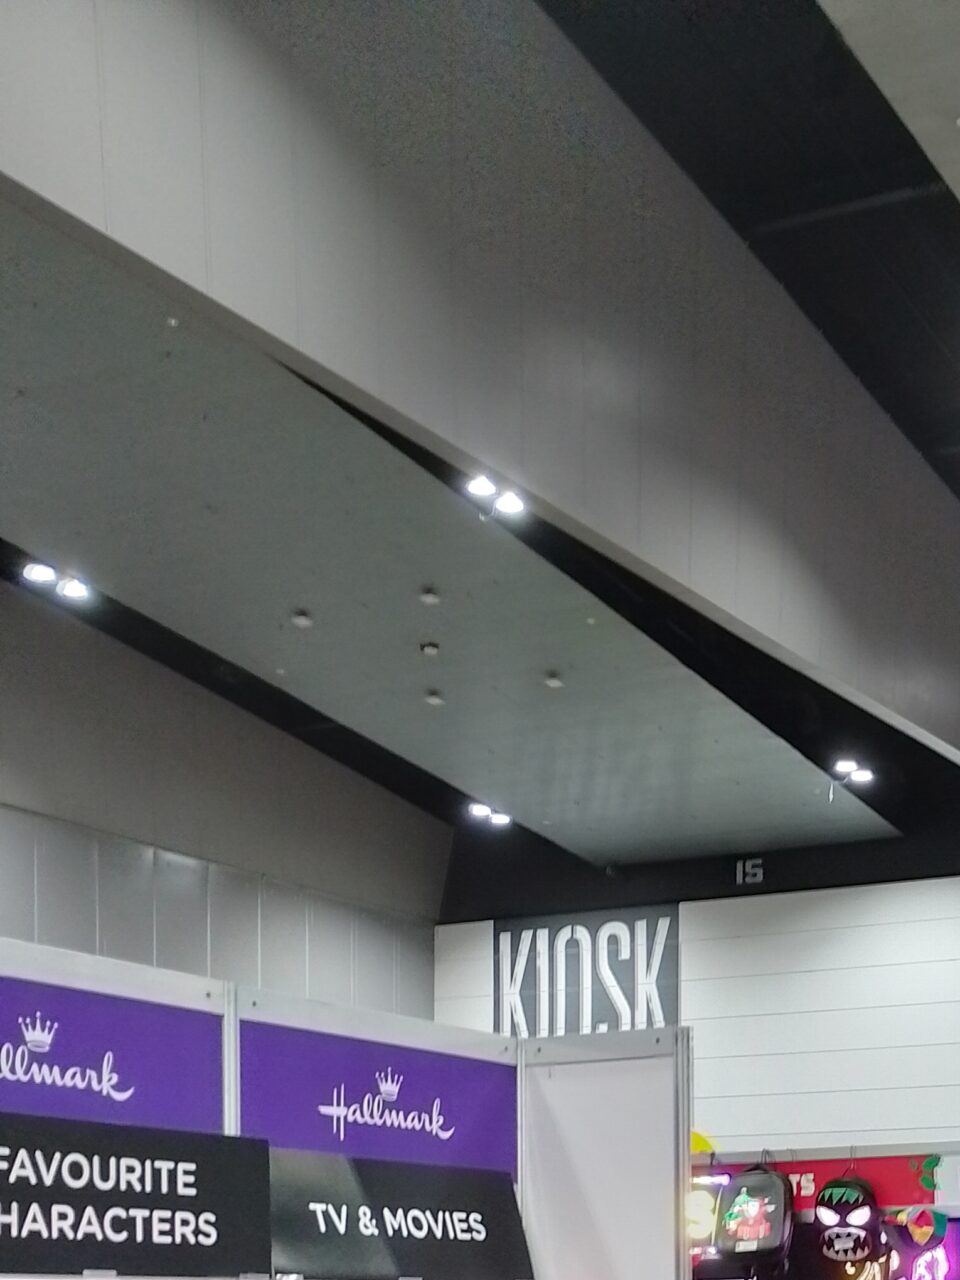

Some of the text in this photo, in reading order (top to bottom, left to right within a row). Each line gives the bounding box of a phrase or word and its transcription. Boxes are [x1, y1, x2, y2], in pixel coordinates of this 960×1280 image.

[736, 858, 763, 885] 15
[499, 917, 671, 1039] KIOSK
[318, 1082, 456, 1142] Hallmark
[308, 1202, 487, 1242] TV & MOVIES
